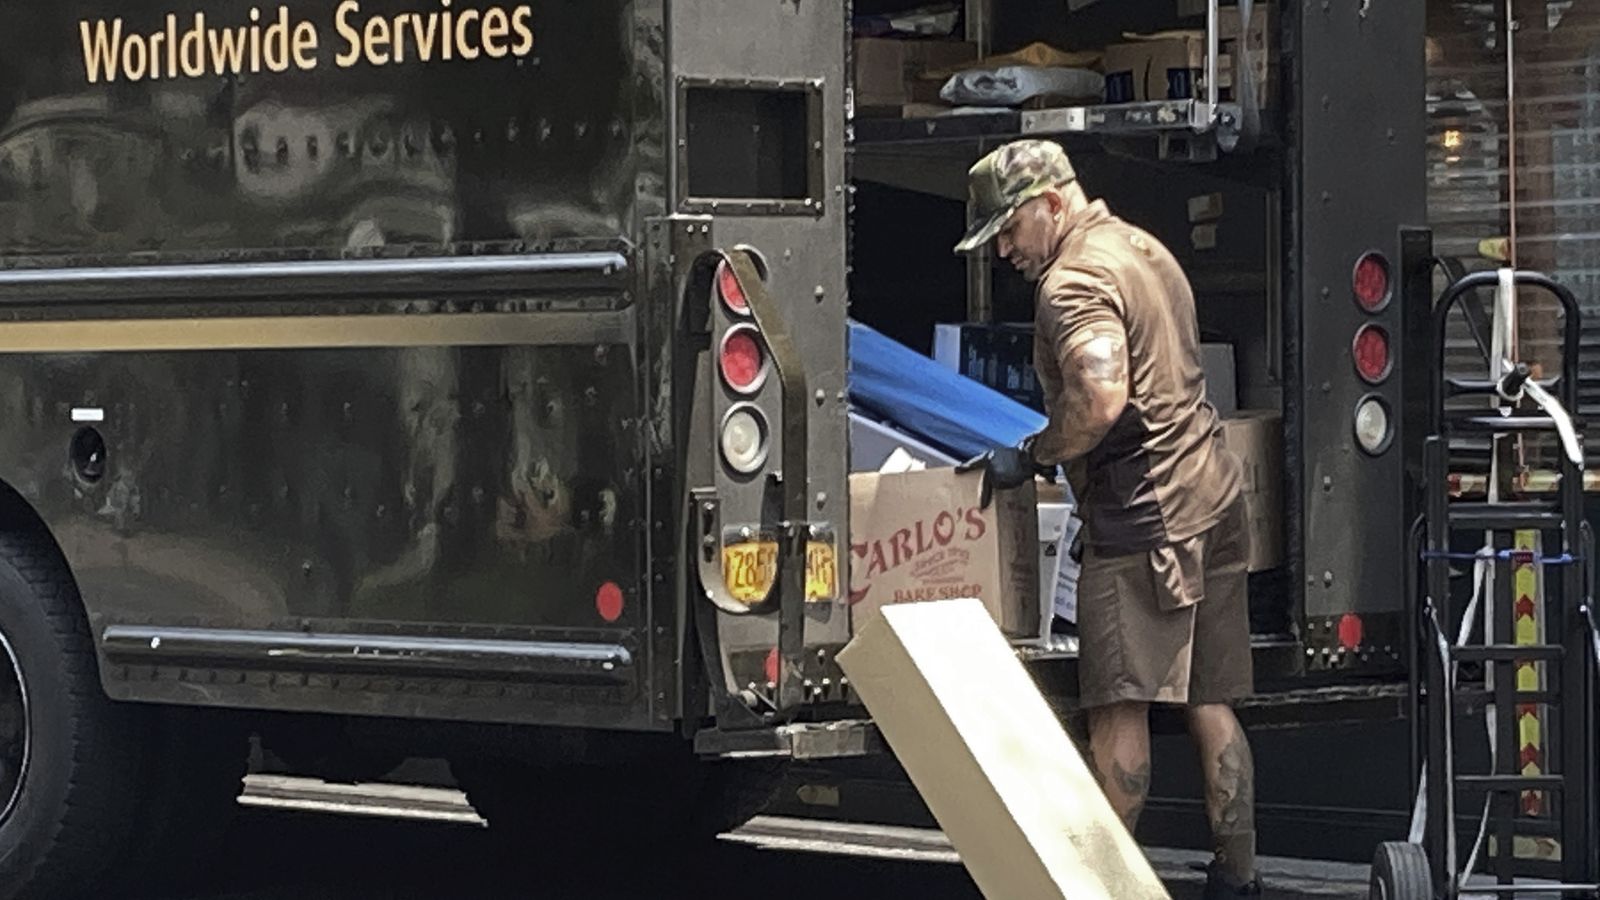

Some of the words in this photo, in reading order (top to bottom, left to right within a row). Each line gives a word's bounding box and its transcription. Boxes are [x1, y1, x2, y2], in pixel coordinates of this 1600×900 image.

[79, 5, 318, 83] Worldwide
[335, 0, 534, 67] Services
[893, 587, 936, 603] BAKE
[938, 583, 982, 600] SHOP
